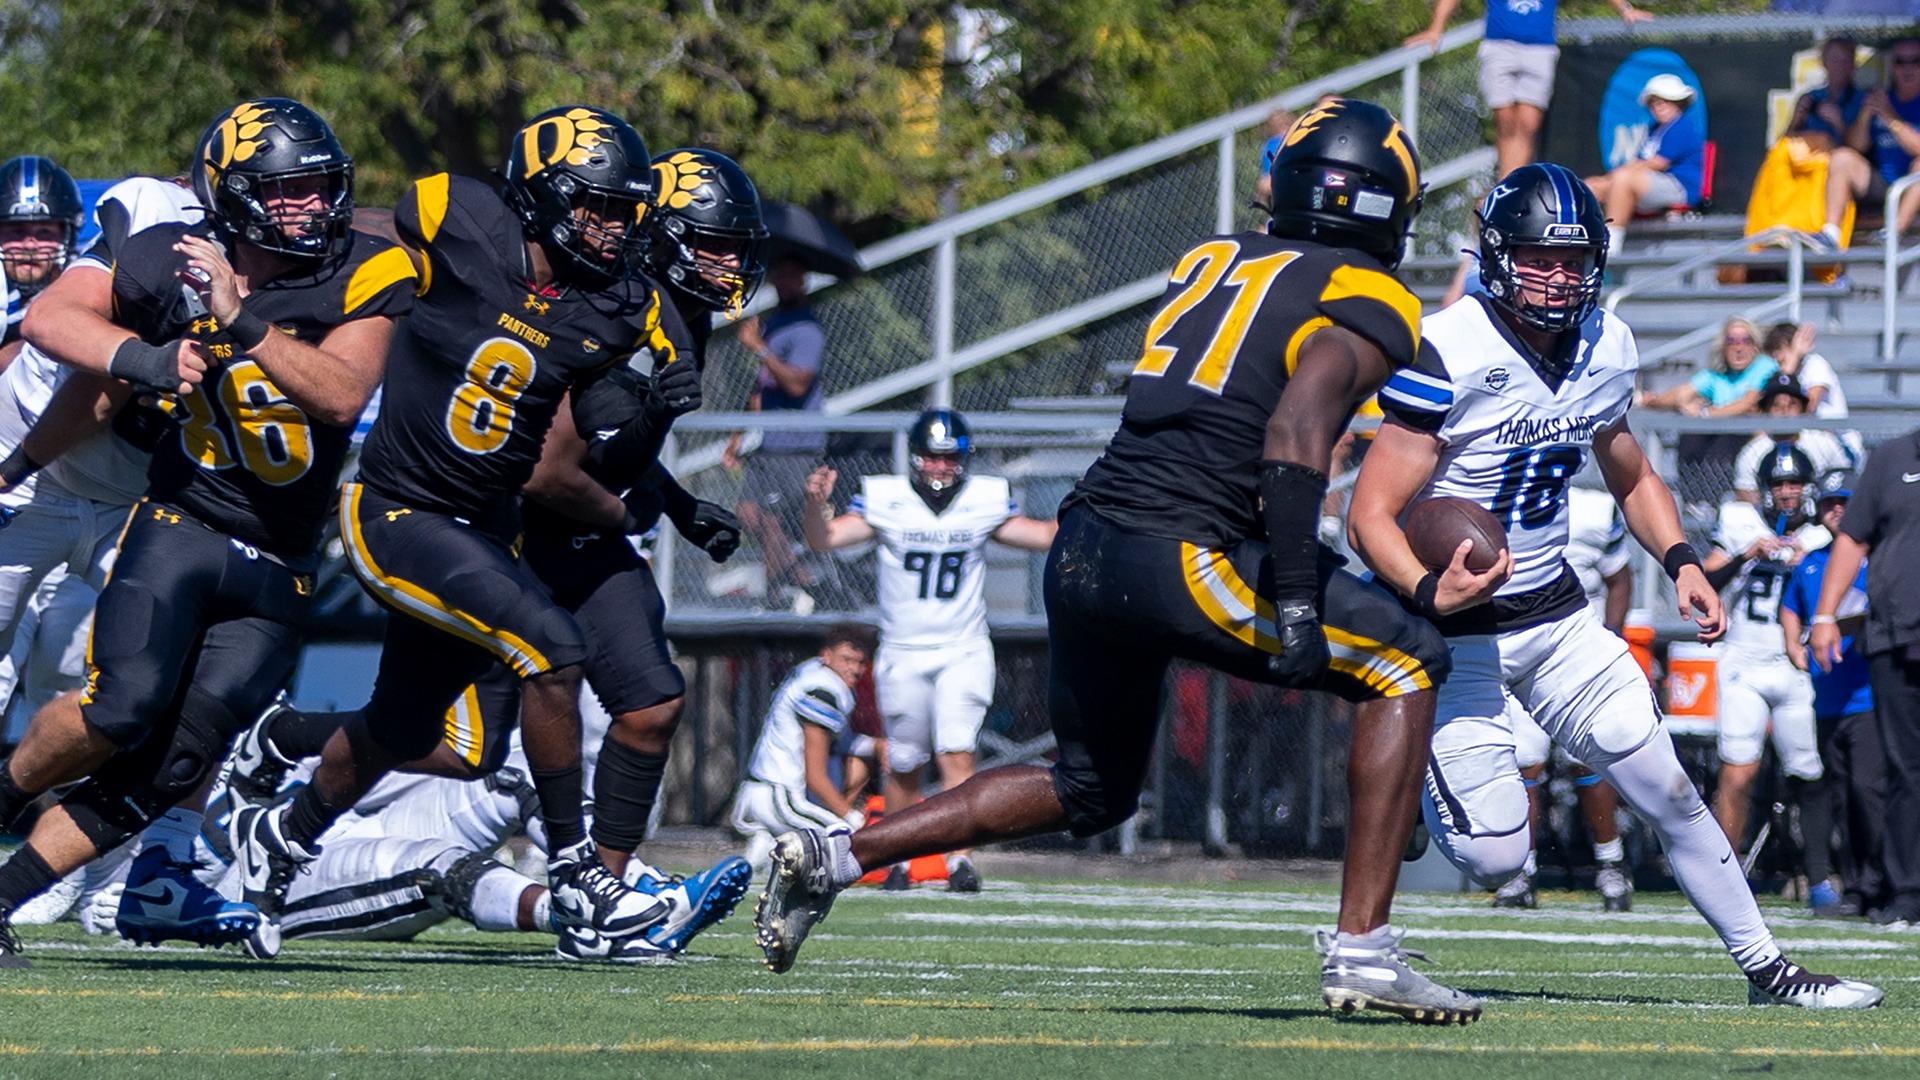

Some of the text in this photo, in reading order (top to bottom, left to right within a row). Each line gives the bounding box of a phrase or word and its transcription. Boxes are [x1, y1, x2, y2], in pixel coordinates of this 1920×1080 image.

[1337, 195, 1348, 206] 21
[1572, 228, 1580, 236] IT
[497, 312, 551, 349] PANTHERS
[1132, 240, 1304, 396] 21
[446, 337, 537, 455] 8
[1495, 418, 1562, 446] THOMAS
[1490, 446, 1582, 533] 18
[904, 551, 968, 600] 98
